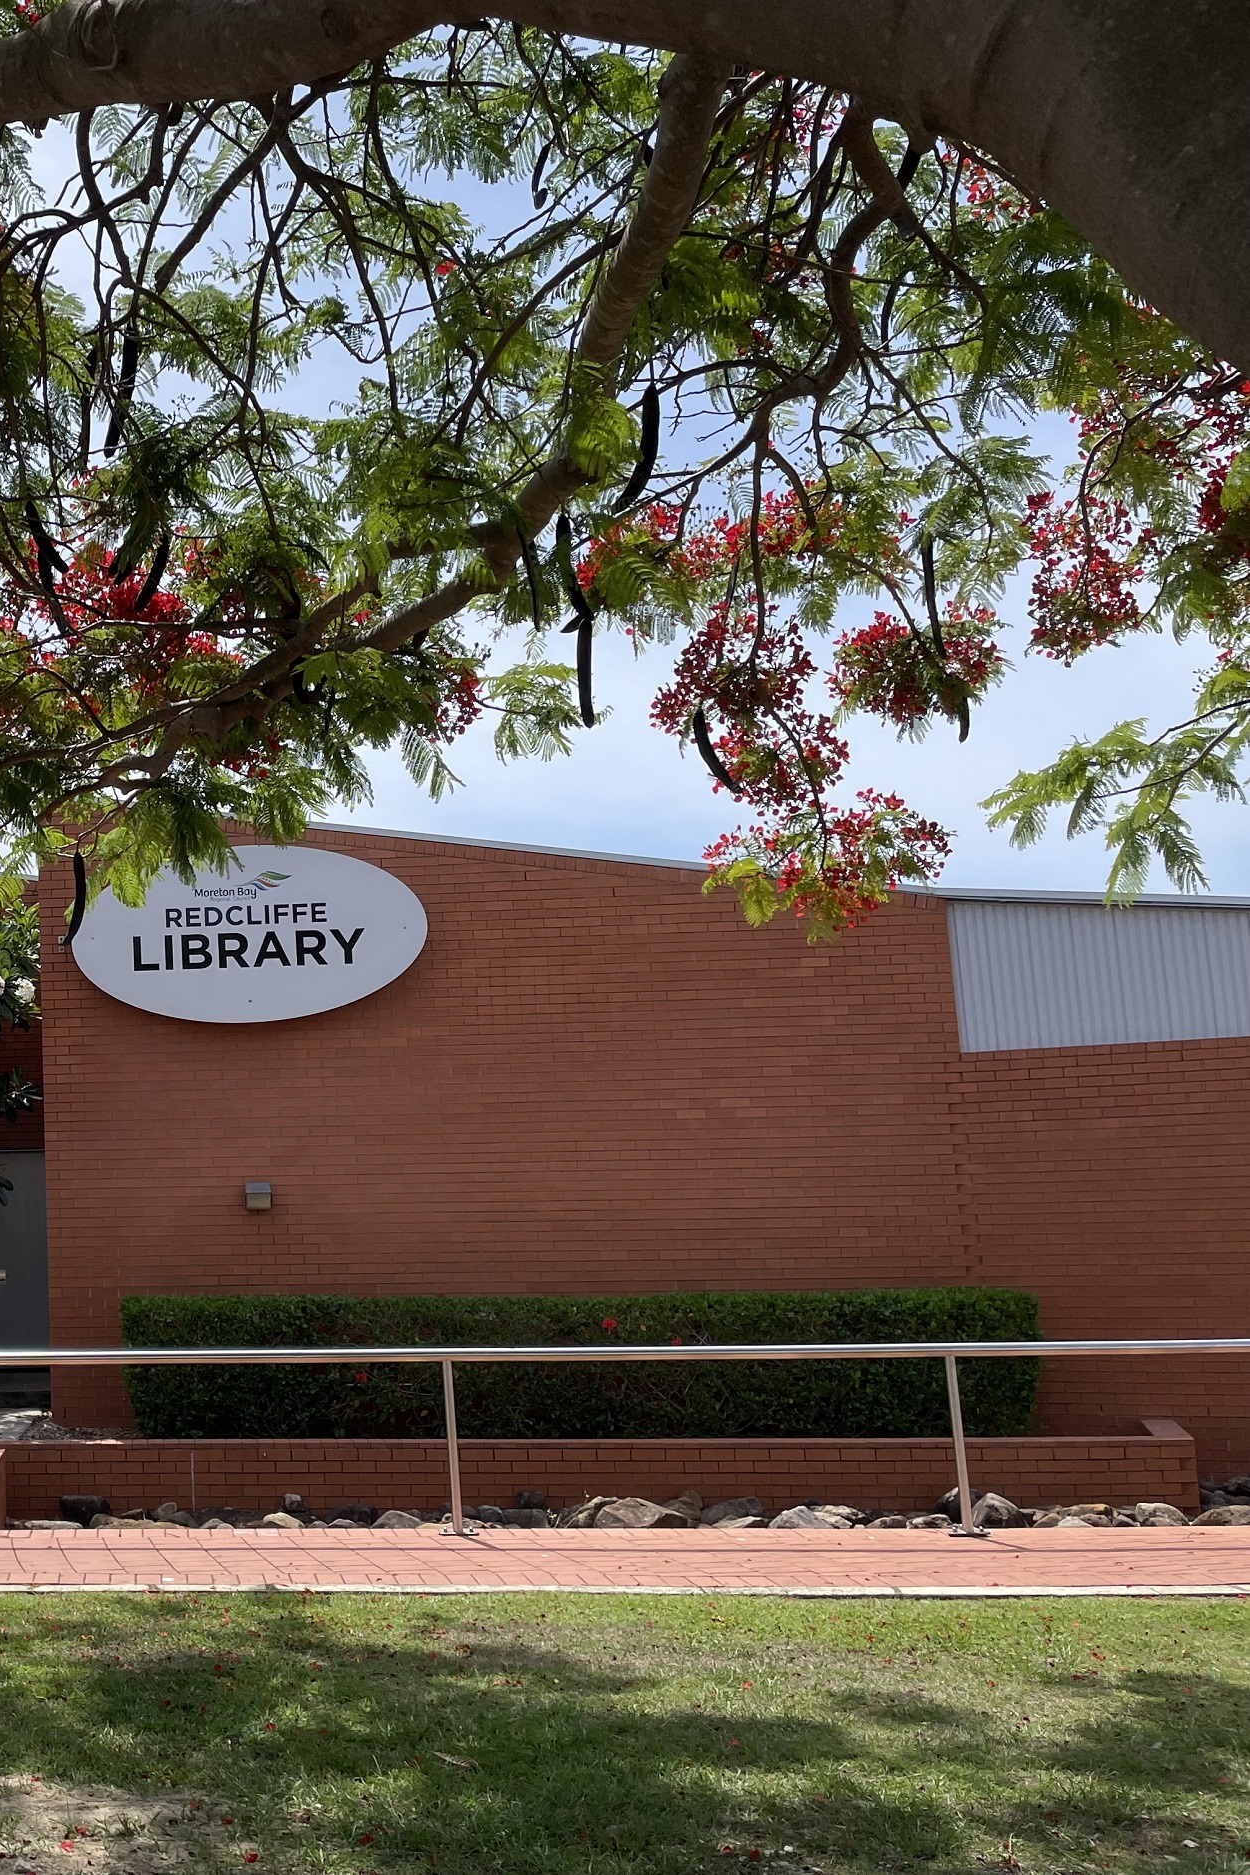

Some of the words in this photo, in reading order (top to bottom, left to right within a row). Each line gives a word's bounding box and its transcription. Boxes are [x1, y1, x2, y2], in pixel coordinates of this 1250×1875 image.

[194, 888, 235, 897] Moreton
[237, 887, 257, 899] Bay
[165, 902, 328, 928] REDCLIFFE
[132, 927, 365, 971] LIBRARY
